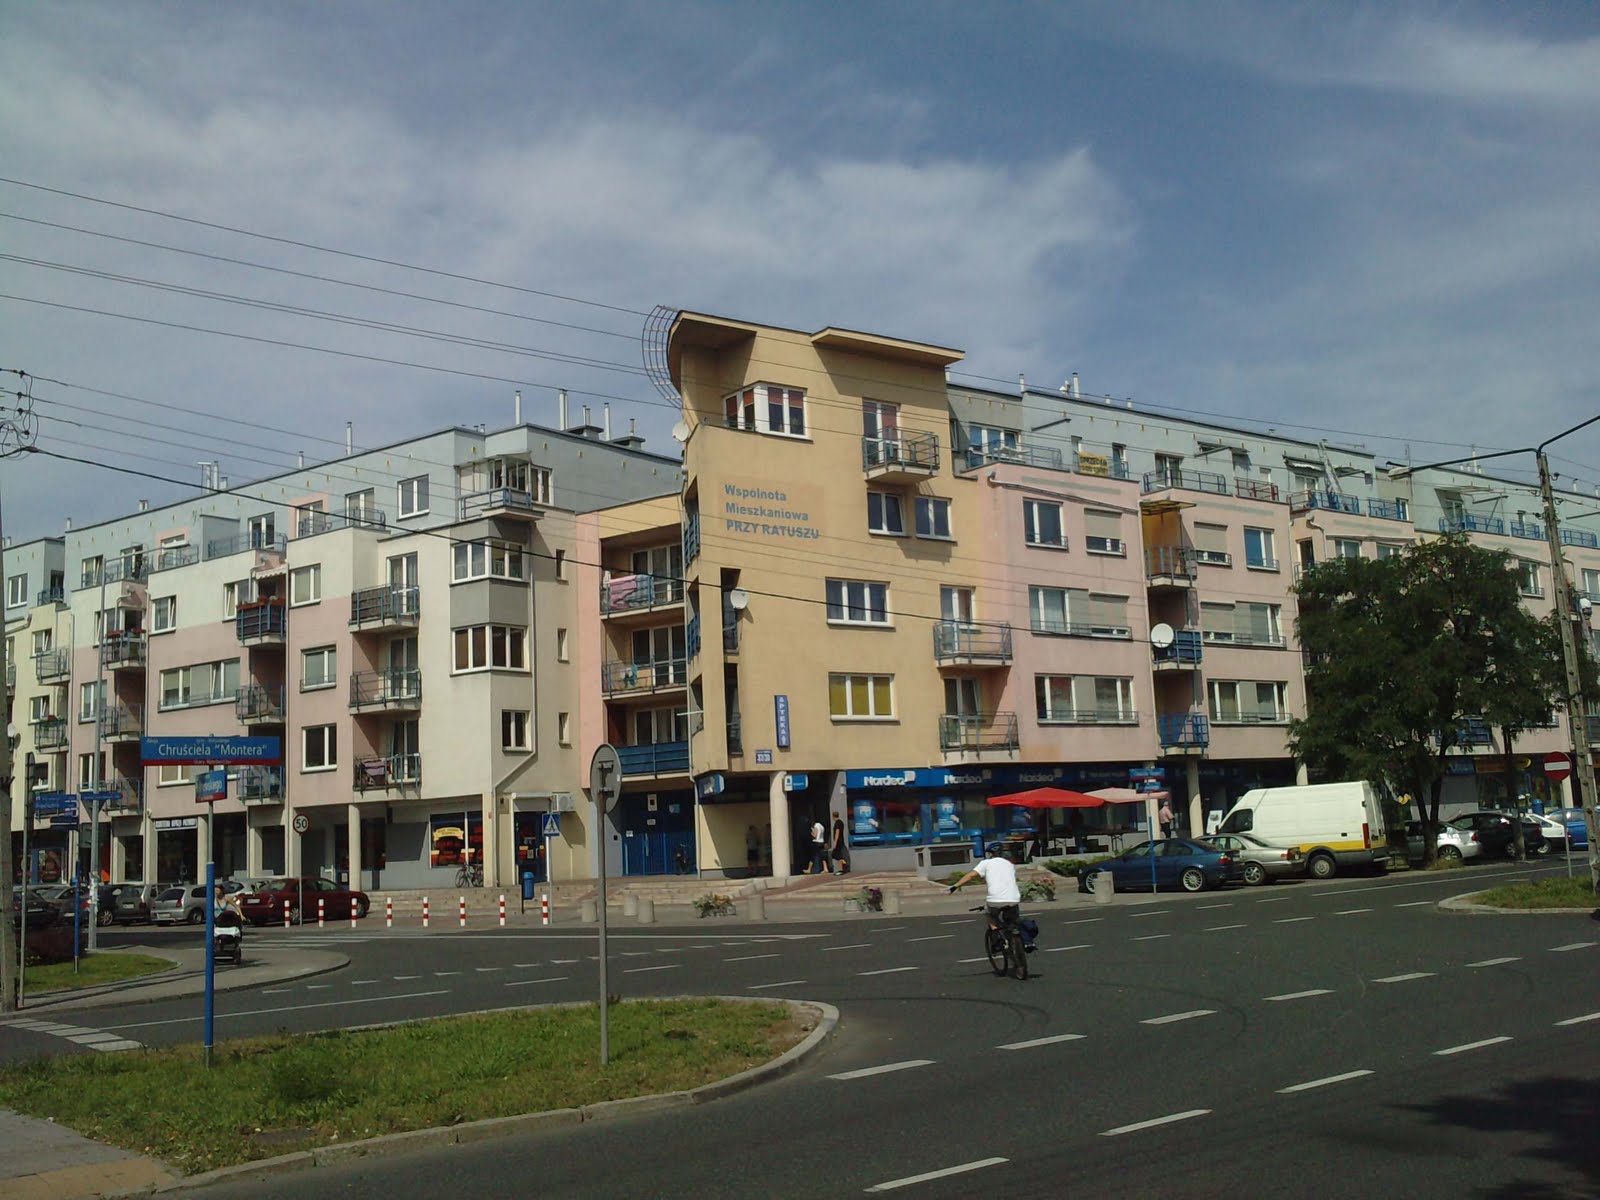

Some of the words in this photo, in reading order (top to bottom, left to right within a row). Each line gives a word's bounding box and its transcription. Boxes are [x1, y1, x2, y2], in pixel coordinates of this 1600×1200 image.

[725, 502, 809, 521] Mieszkaniowa
[726, 520, 759, 534] PRZY
[762, 525, 820, 539] RATUSZU
[158, 743, 211, 756] Chruściela
[863, 775, 905, 786] Nordea
[944, 774, 982, 785] Nordea
[296, 818, 307, 829] 50
